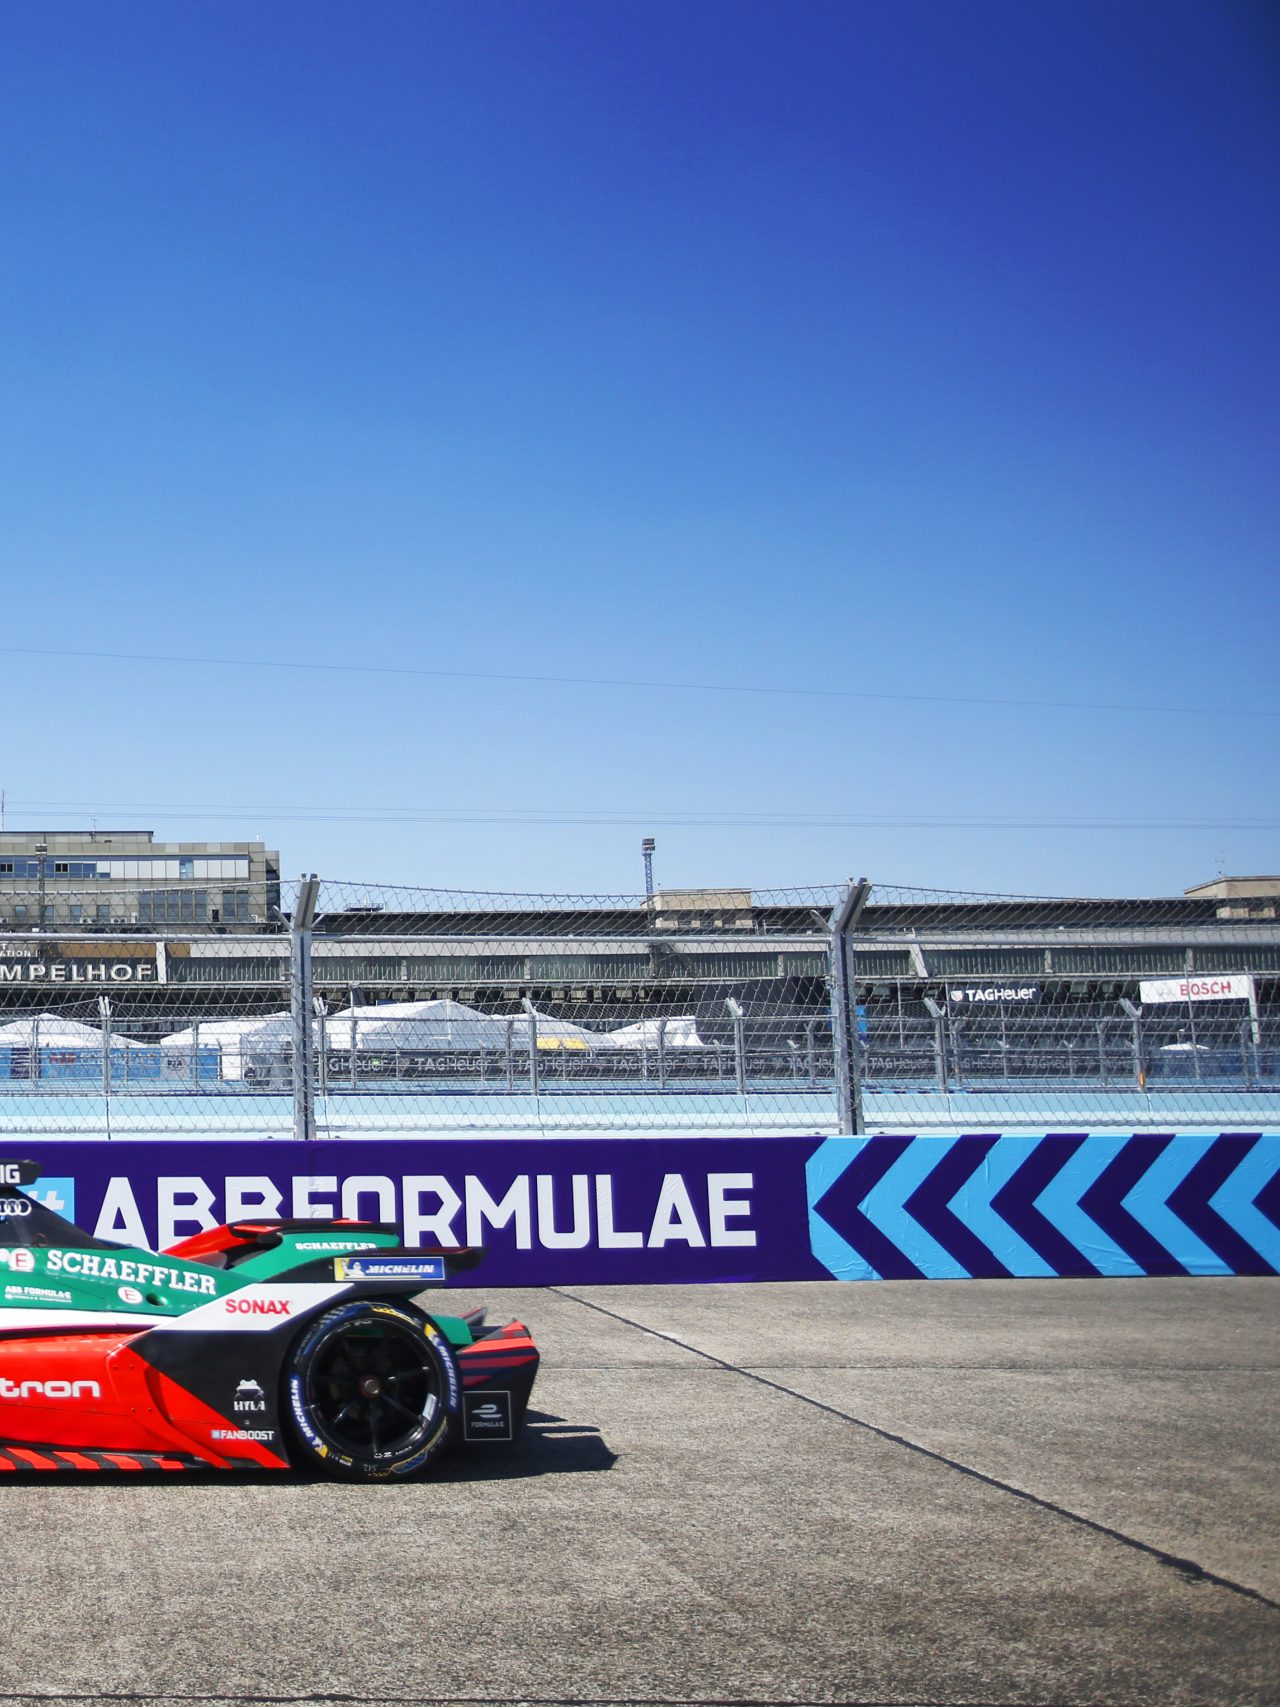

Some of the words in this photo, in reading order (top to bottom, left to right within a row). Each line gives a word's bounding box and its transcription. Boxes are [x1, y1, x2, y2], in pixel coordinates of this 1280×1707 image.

[1180, 981, 1232, 997] BOSCH
[294, 1242, 377, 1250] SCHAEFFLER
[46, 1249, 217, 1295] SCHAEFFLER
[365, 1264, 435, 1274] MICHELIN
[225, 1298, 290, 1315] SONAX
[438, 1344, 457, 1408] MICHELIN
[233, 1400, 266, 1411] HYLA
[289, 1378, 315, 1439] MICHELIN
